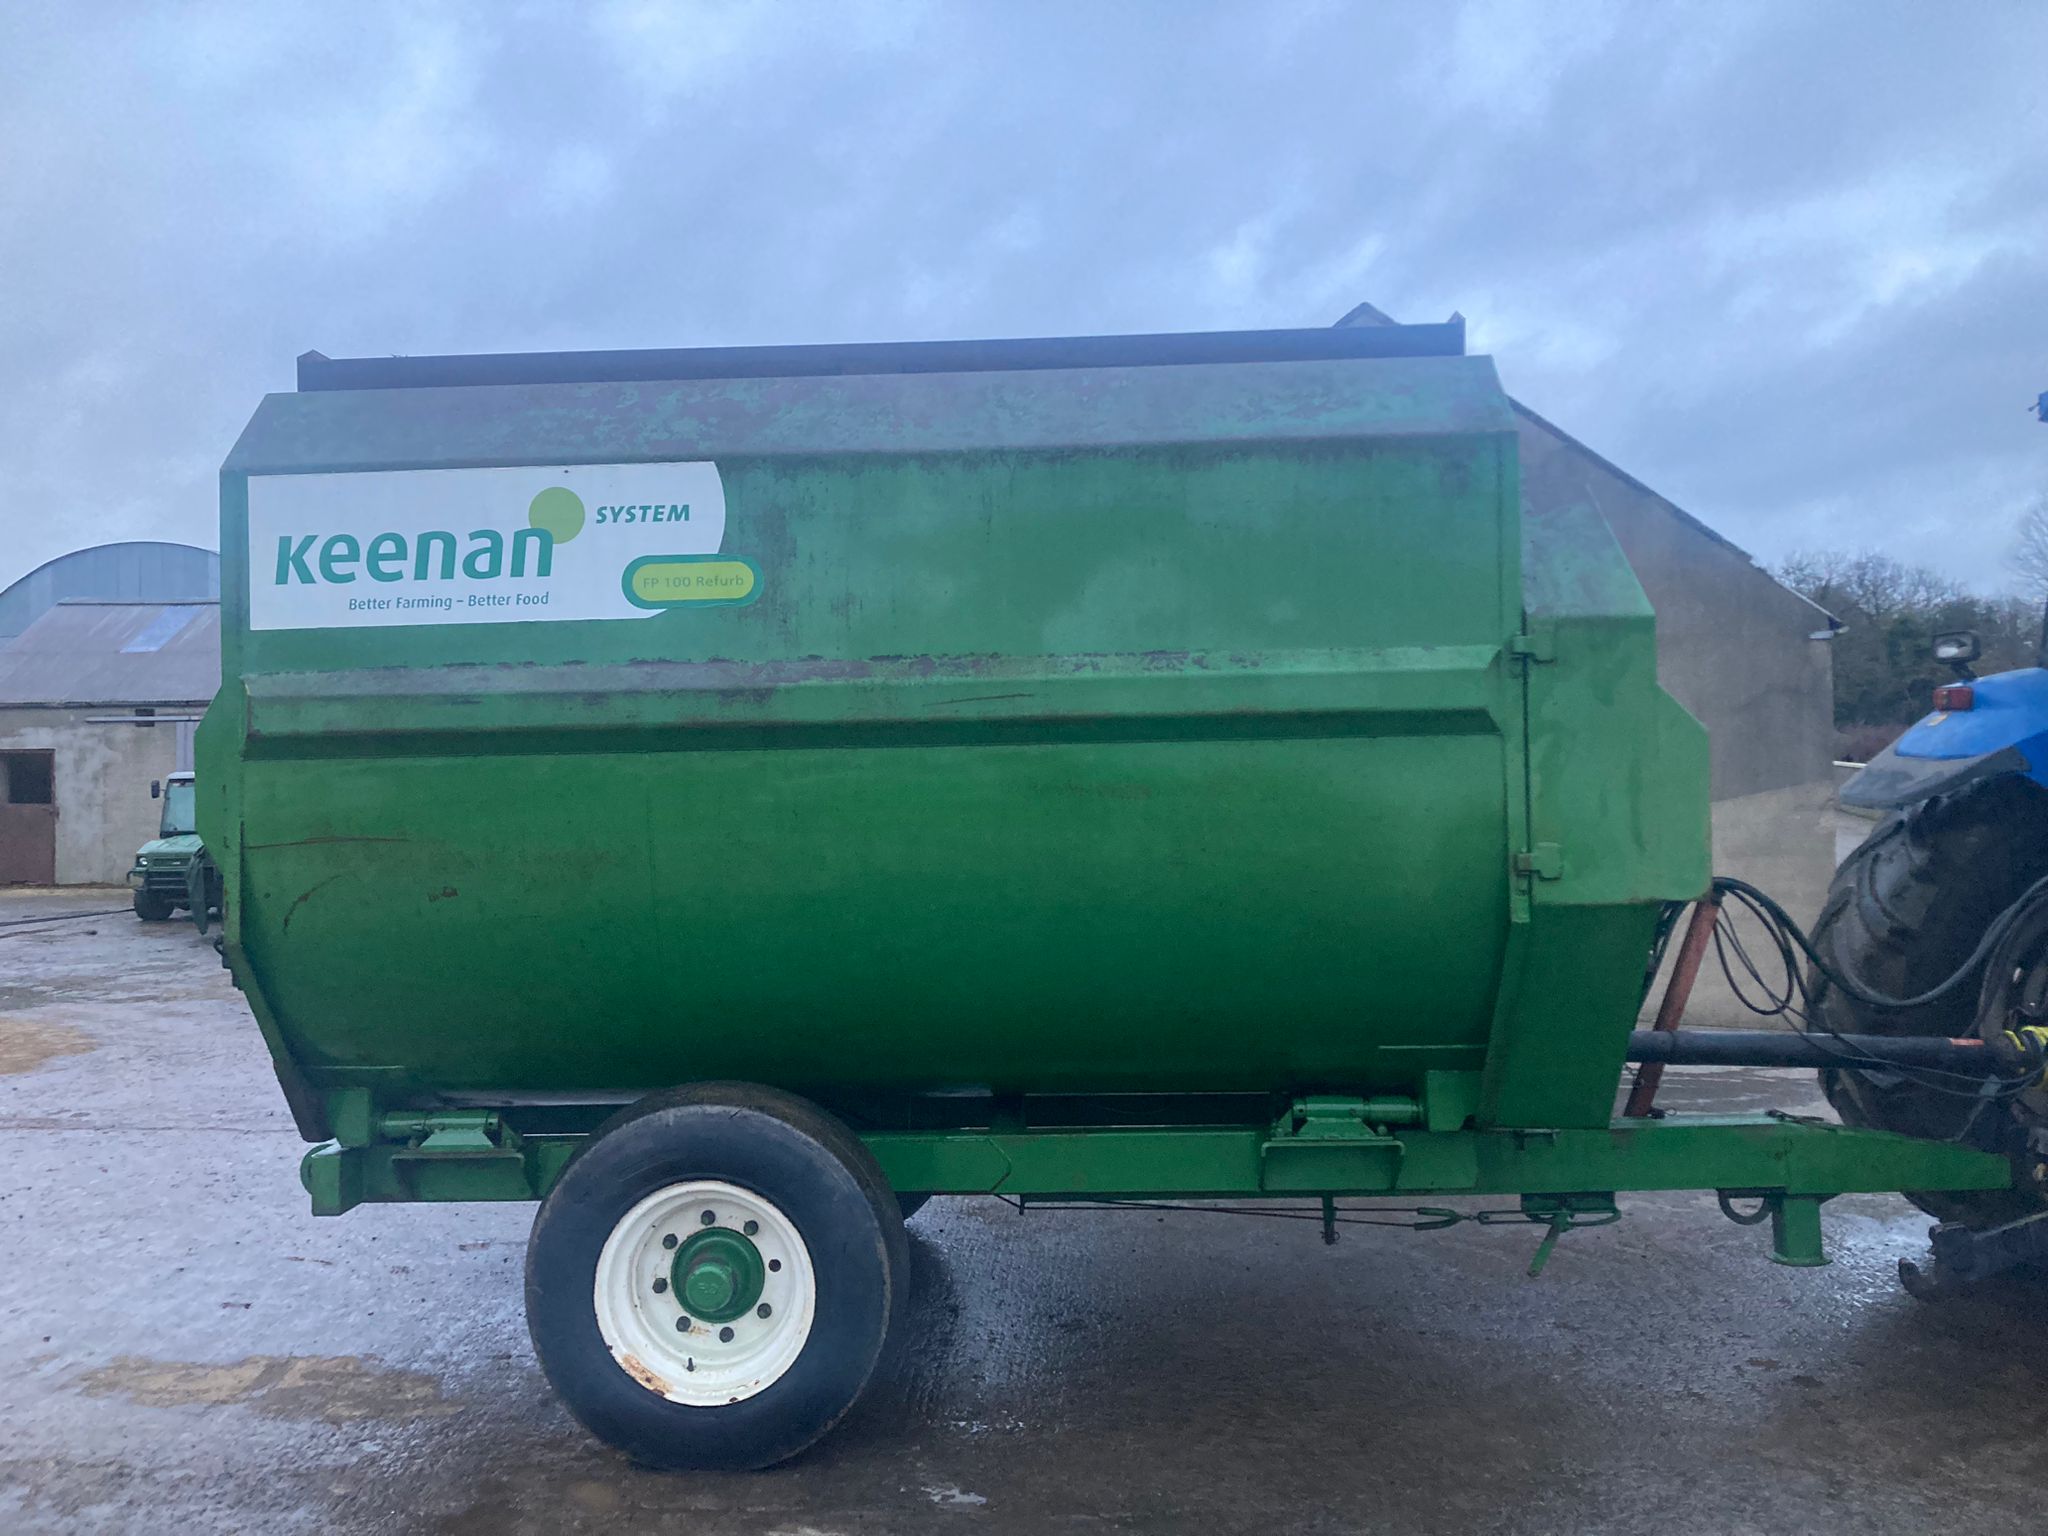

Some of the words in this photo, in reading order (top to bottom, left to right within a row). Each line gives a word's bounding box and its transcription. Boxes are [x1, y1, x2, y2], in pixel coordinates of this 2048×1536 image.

[596, 504, 691, 524] SYSTEM
[275, 528, 554, 585] Keenan
[642, 577, 660, 588] FP
[665, 577, 691, 588] 100
[696, 573, 745, 588] Refurb
[348, 596, 391, 611] Better
[395, 594, 453, 612] Farming
[467, 594, 511, 608] Better
[515, 592, 550, 606] Food
